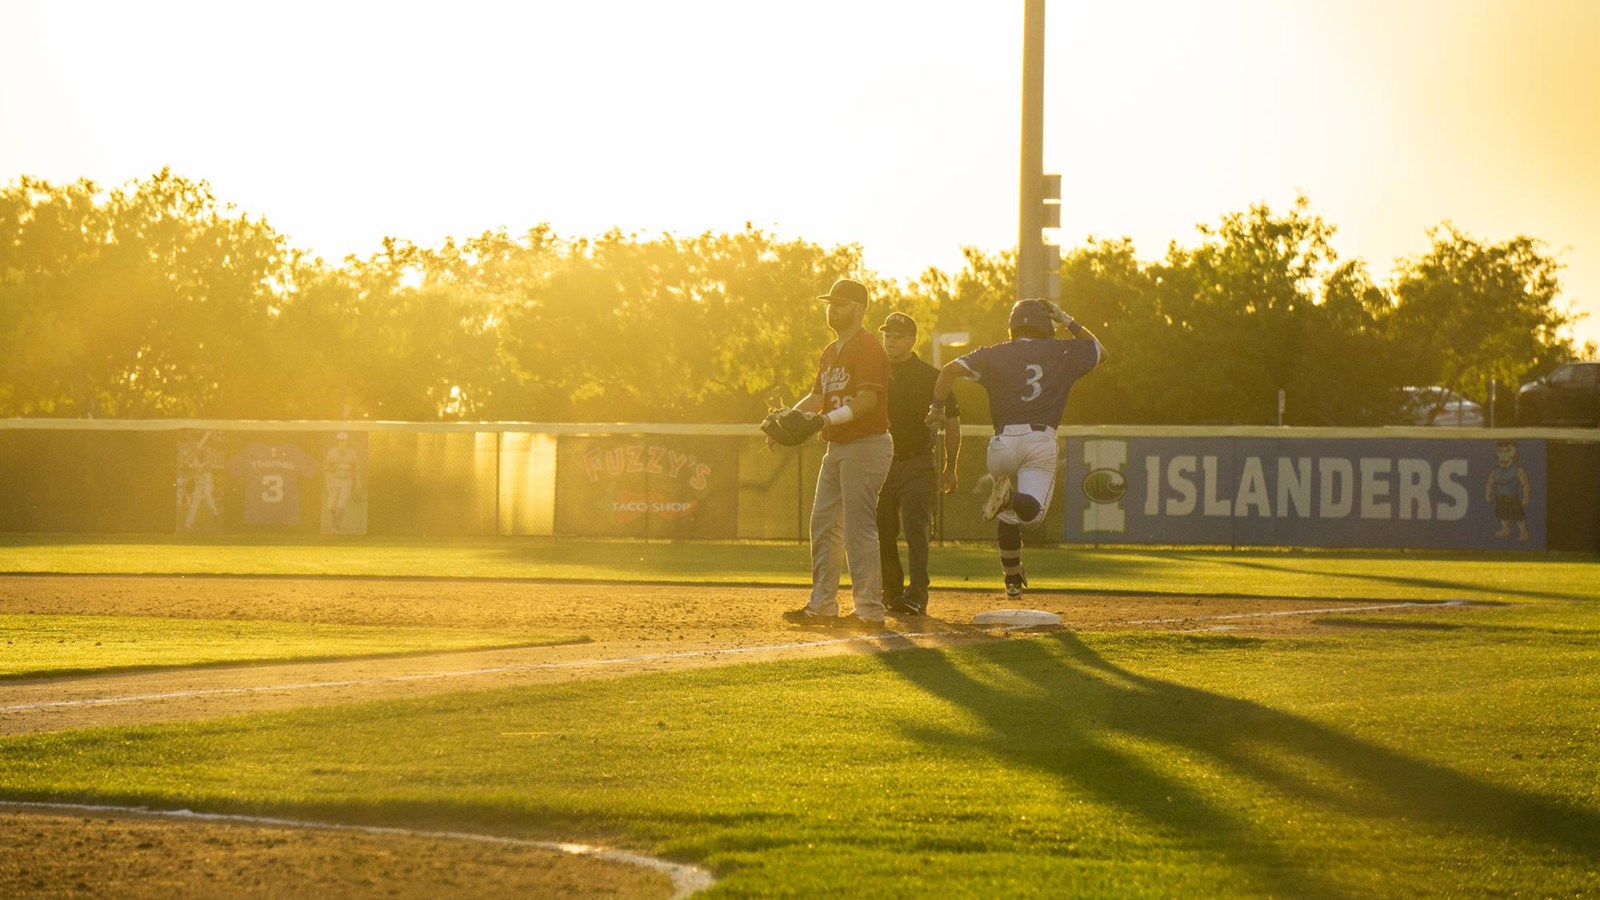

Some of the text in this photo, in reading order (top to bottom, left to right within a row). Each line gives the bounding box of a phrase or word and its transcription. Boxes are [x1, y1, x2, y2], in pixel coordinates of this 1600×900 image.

[1021, 364, 1043, 401] 3
[250, 459, 295, 470] Thomas
[583, 445, 711, 490] FUZZY'S
[261, 474, 284, 503] 3
[1144, 455, 1469, 521] ISLANDERS
[612, 502, 691, 512] TACO SHOP
